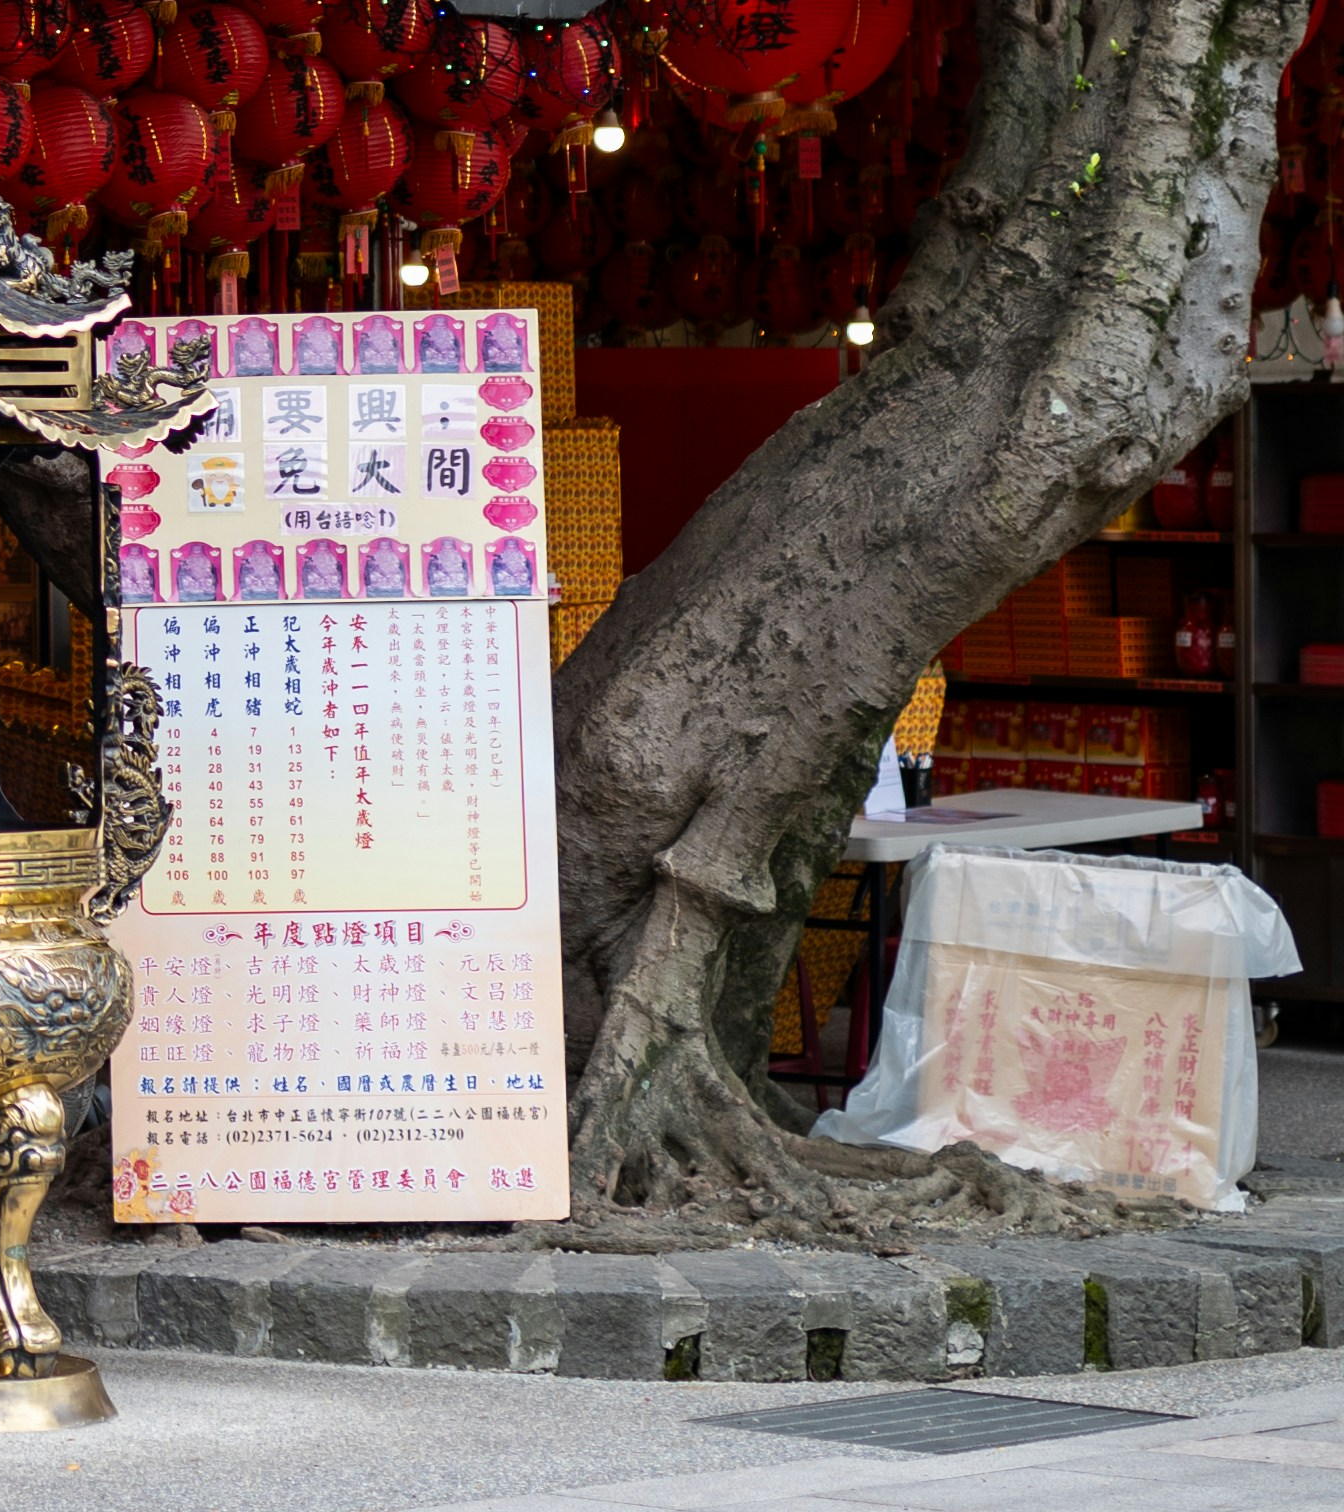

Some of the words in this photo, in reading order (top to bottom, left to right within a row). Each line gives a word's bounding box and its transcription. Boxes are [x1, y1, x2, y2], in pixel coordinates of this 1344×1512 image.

[273, 447, 471, 497] 免大間
[163, 616, 184, 718] 偏沖相猴
[203, 615, 223, 718] 偏沖相虎
[243, 615, 262, 717] 正沖相豬
[282, 616, 303, 717] 犯太歲相蛇
[168, 729, 180, 739] 10
[211, 729, 217, 738] 4
[251, 728, 257, 738] 7
[290, 727, 296, 737] 1
[348, 614, 375, 850] 安奉一一四年值年太歲燈
[167, 747, 181, 756] 22
[208, 746, 222, 756] 16
[248, 746, 262, 755] 19
[289, 745, 302, 755] 13
[168, 764, 181, 774] 34
[209, 764, 222, 774] 28
[249, 763, 262, 773] 31
[289, 763, 303, 772] 25
[168, 782, 182, 792] 46
[209, 782, 223, 791] 40
[249, 781, 263, 791] 43
[289, 781, 303, 791] 37
[209, 800, 223, 809] 52
[249, 799, 263, 809] 55
[289, 798, 303, 808] 49
[210, 817, 223, 827] 64
[250, 817, 263, 827] 67
[290, 816, 303, 826] 61
[169, 836, 183, 845] 82
[210, 835, 224, 845] 76
[250, 835, 264, 844] 79
[290, 834, 304, 844] 73
[169, 853, 183, 863] 94
[210, 853, 224, 862] 88
[251, 852, 264, 862] 91
[291, 852, 305, 862] 85
[166, 871, 189, 881] 106
[207, 871, 228, 881] 100
[248, 870, 269, 880] 103
[291, 870, 305, 880] 97
[254, 919, 425, 950] 年度點燈項目
